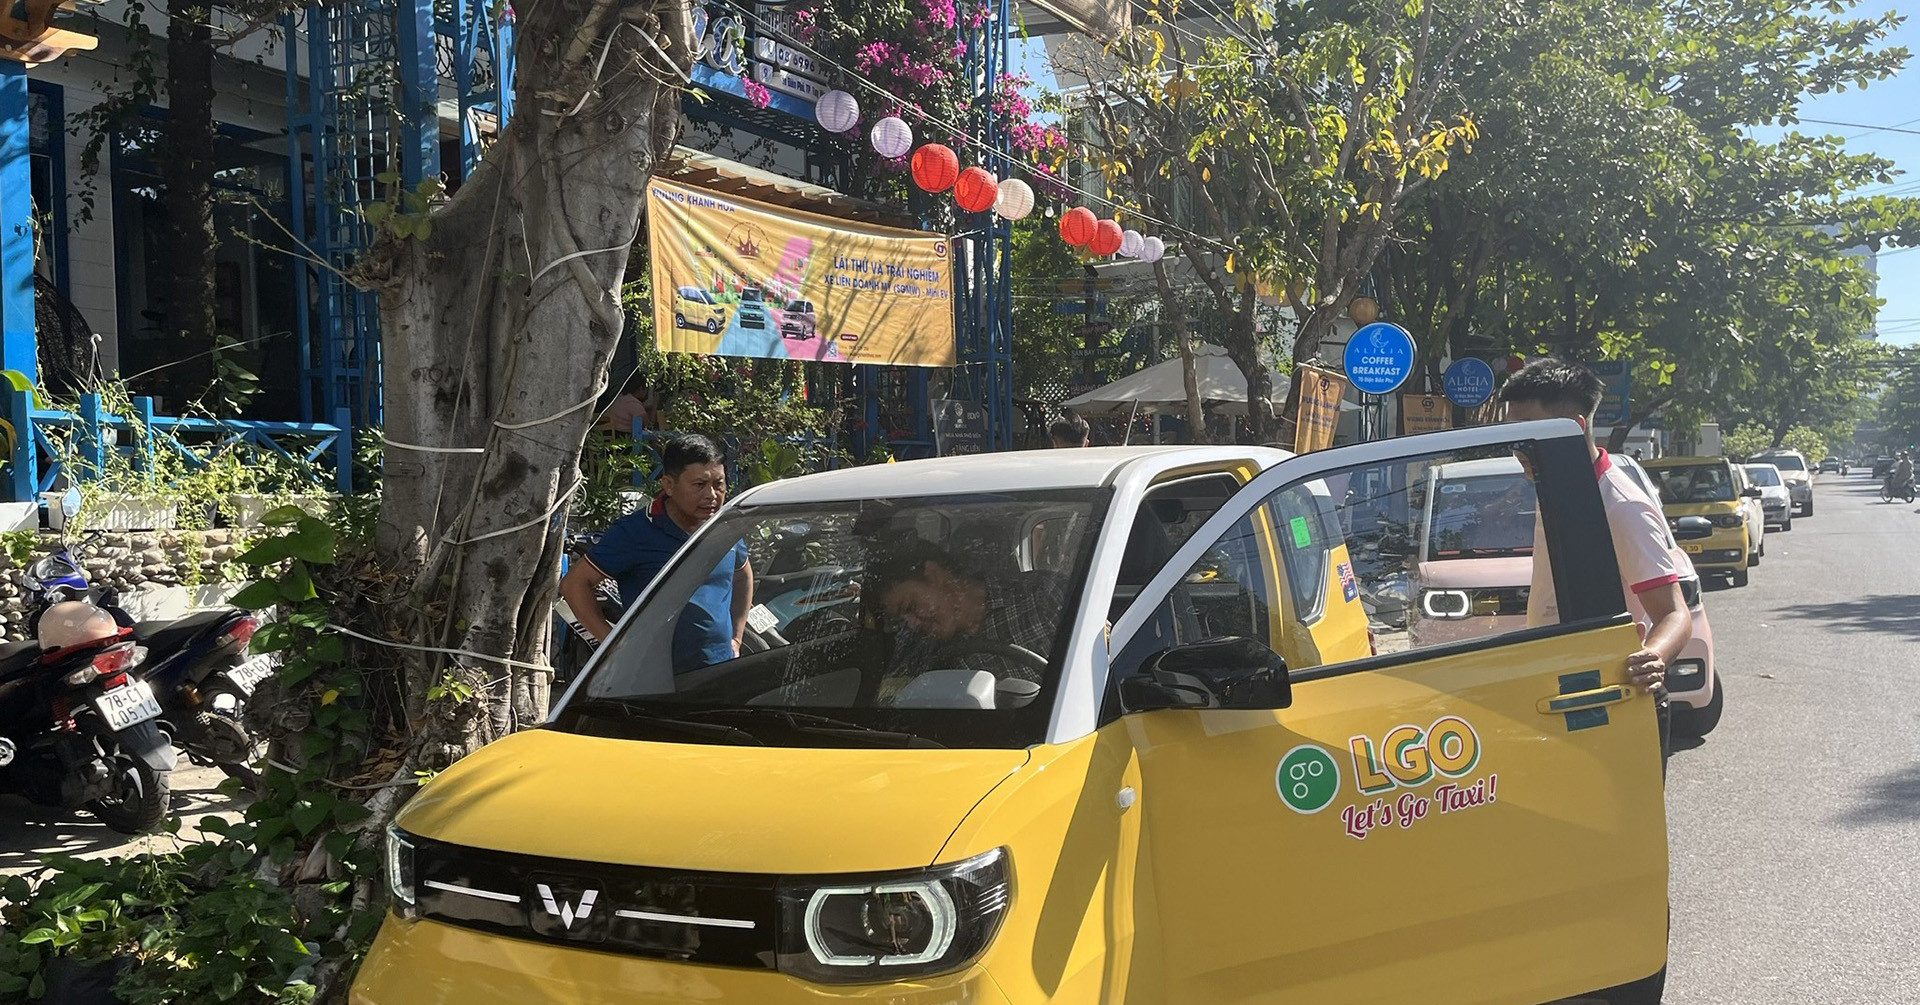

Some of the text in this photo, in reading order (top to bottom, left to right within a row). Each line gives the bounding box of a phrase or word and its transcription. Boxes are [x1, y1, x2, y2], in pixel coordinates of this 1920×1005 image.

[871, 260, 884, 276] VÀ
[824, 274, 834, 285] XE
[853, 278, 880, 290] DOANH
[1354, 347, 1404, 355] ALICIA
[1361, 356, 1395, 365] COFFEE
[1352, 366, 1401, 376] BREAKFAST
[1448, 376, 1489, 386] ALICIA
[104, 687, 144, 710] 78-C1
[109, 702, 159, 728] 405.14
[1350, 716, 1480, 795] LGO
[1290, 761, 1324, 799] go
[1342, 799, 1393, 839] Let's
[1397, 792, 1431, 829] Go
